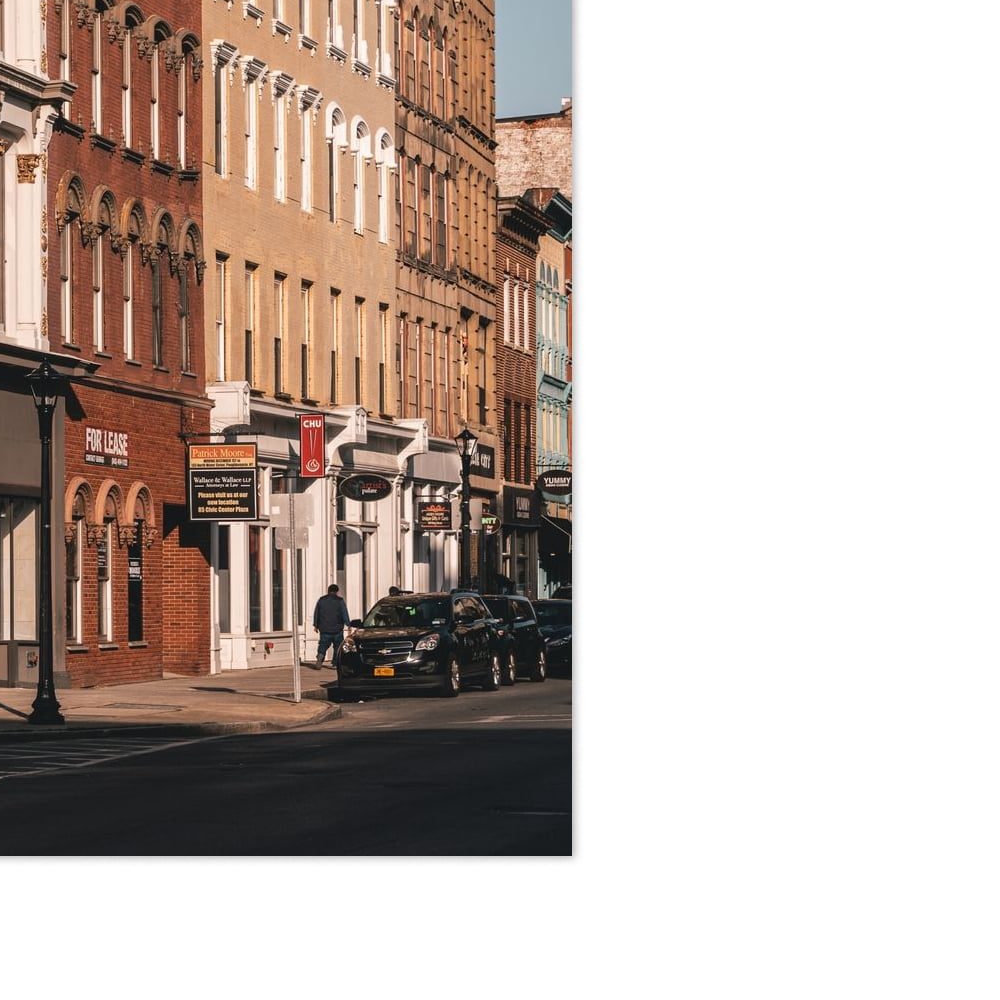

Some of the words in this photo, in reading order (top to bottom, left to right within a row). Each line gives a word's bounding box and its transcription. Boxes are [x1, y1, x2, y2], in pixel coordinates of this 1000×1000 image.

[303, 420, 321, 428] CHU
[85, 427, 102, 452] FOR
[104, 430, 128, 456] LEASE
[192, 448, 218, 458] Patrick
[220, 448, 245, 458] Moore
